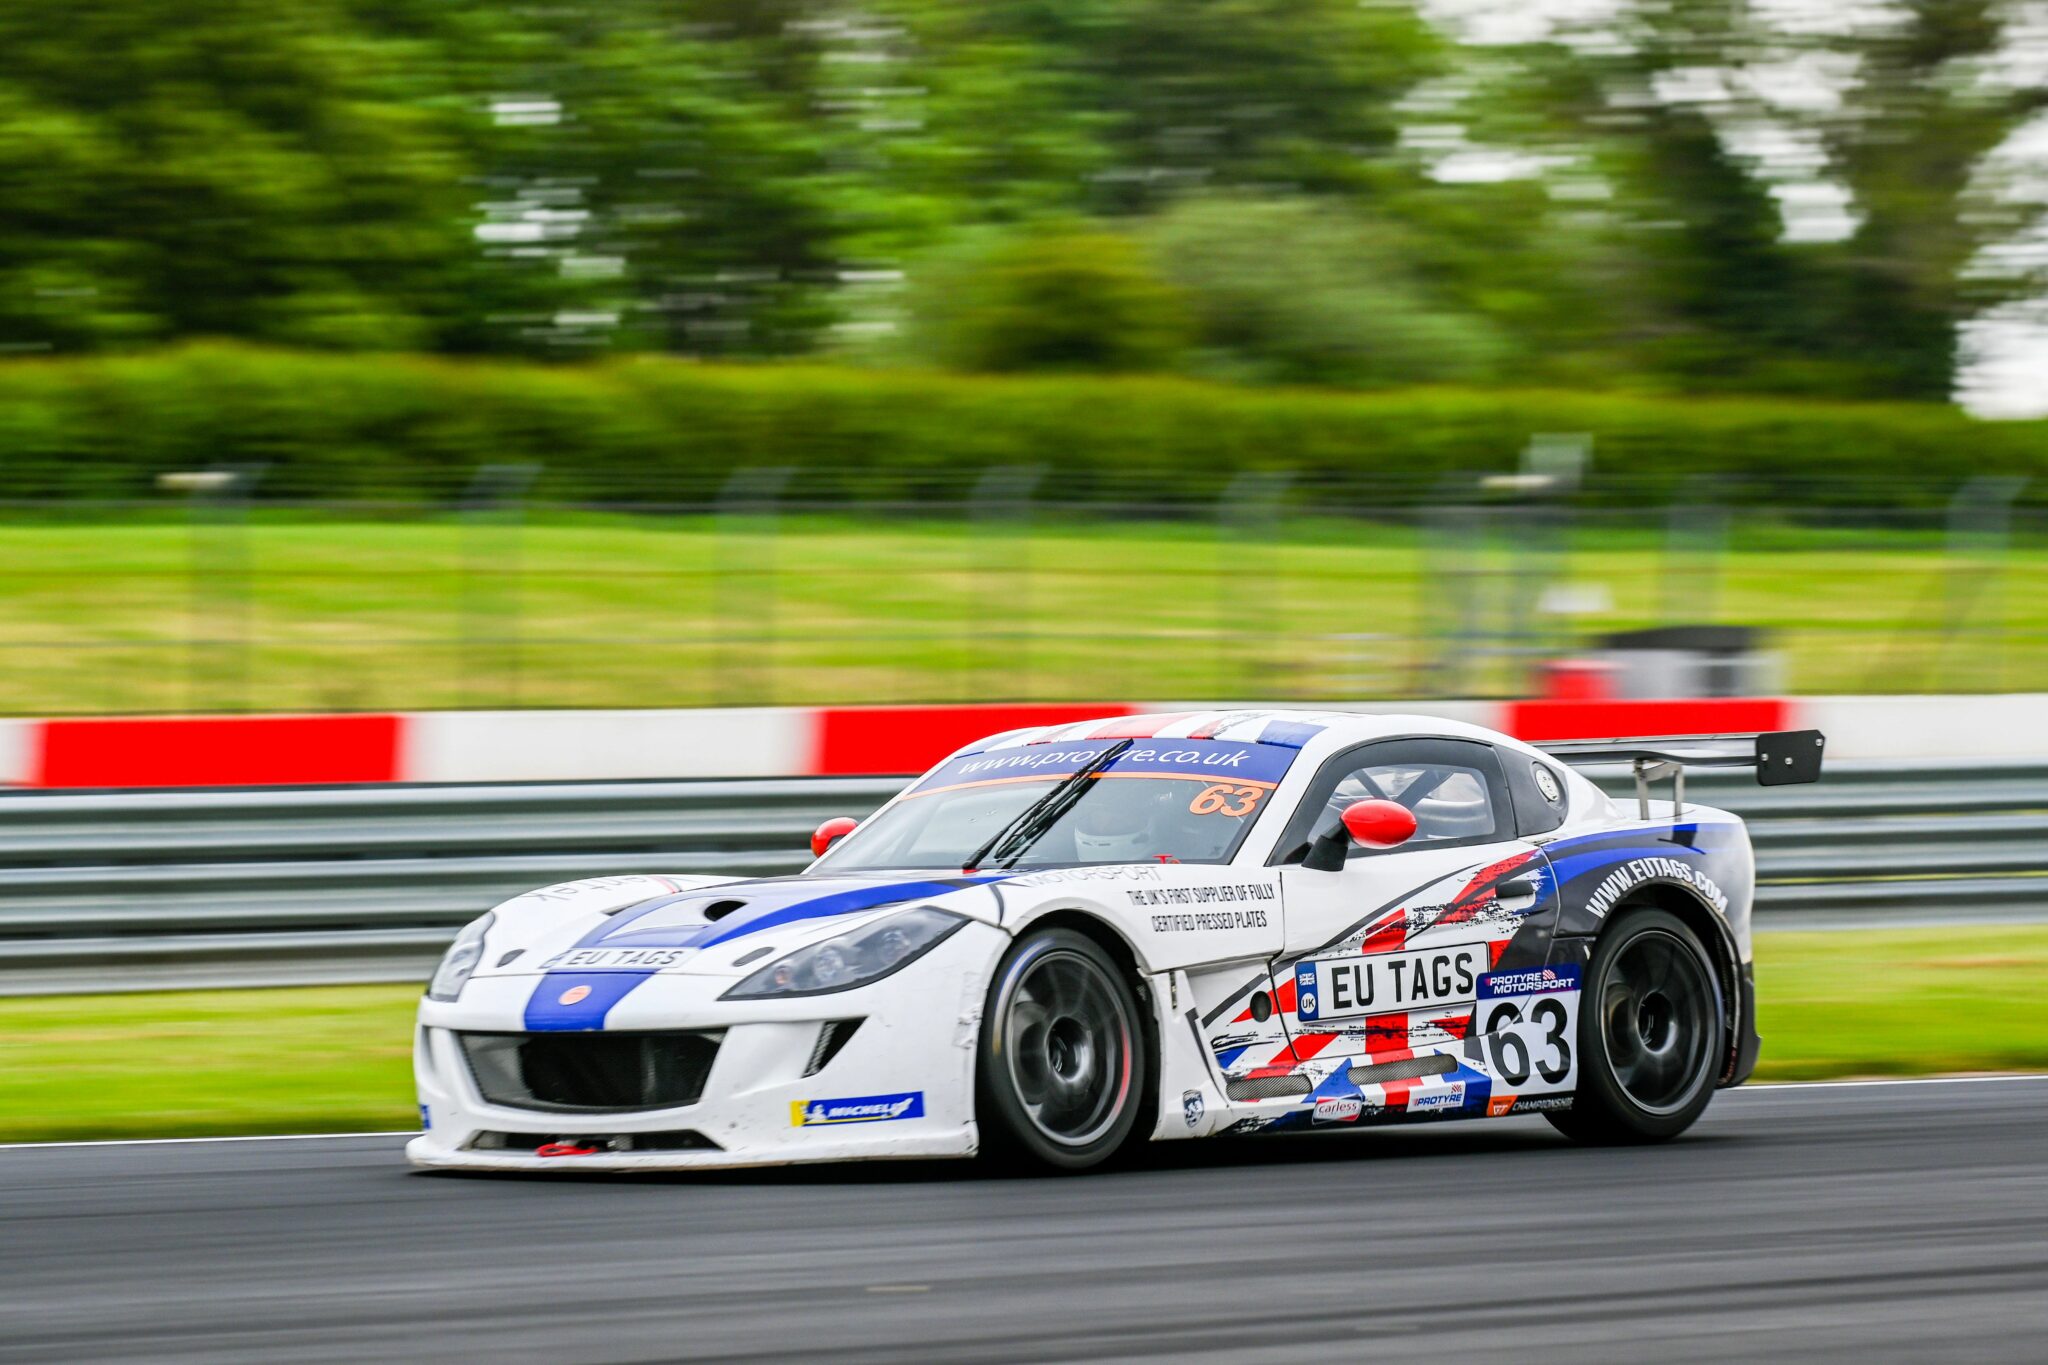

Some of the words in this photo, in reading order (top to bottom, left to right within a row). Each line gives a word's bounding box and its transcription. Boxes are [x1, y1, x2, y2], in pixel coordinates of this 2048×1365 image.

[957, 747, 1252, 775] www.proyre.co.uk
[1188, 784, 1265, 817] 63
[1126, 890, 1148, 906] THE
[1167, 888, 1194, 904] FIRST
[1193, 885, 1236, 903] SUPPLIER
[1236, 884, 1248, 901] OF
[1249, 883, 1275, 900] FULLY
[1585, 857, 1729, 919] WWW.EUTAGS.COM
[1151, 915, 1195, 932] CERTIFIED
[1195, 912, 1234, 930] PRESSED
[1235, 910, 1268, 928] PLATES
[567, 951, 610, 965] EU
[611, 951, 684, 965] TAGS
[1331, 963, 1375, 1010] EU
[1388, 952, 1474, 1002] TAGS
[1489, 972, 1542, 987] PROTYRE
[1493, 978, 1575, 995] MOTORSPORT
[1302, 998, 1315, 1009] UK
[1486, 998, 1572, 1087] 63
[1318, 1101, 1358, 1114] carless
[1417, 1093, 1463, 1106] PROTYRE
